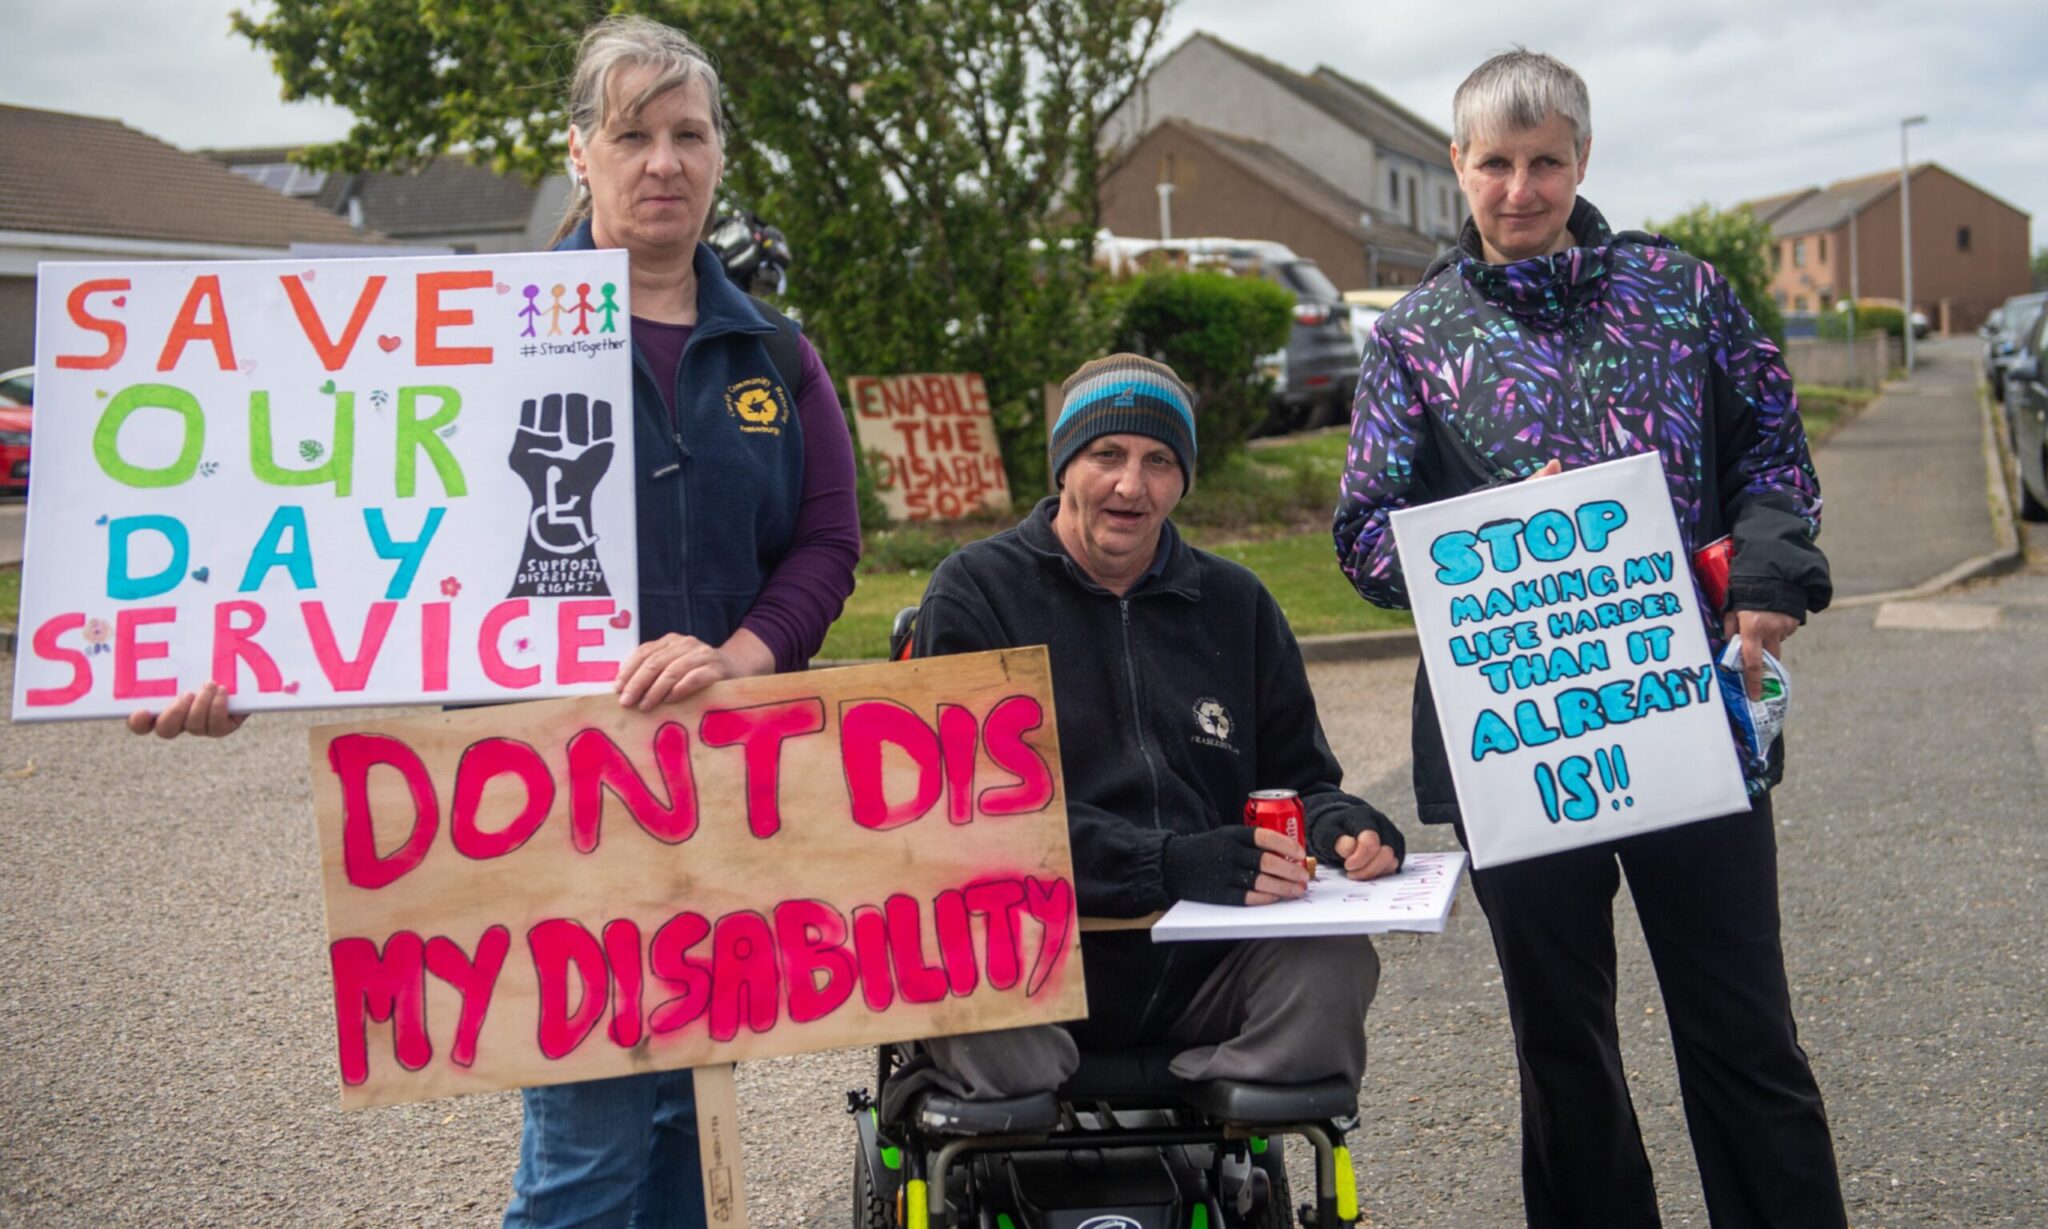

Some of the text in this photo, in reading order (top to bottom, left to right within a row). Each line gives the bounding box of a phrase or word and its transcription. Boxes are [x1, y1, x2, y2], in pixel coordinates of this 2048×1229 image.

[56, 271, 493, 371] SAVE
[520, 338, 627, 359] #StandTogether
[855, 372, 992, 419] ENABLE
[93, 384, 468, 497] OUR
[892, 419, 981, 453] THE
[106, 505, 447, 600] DAY
[518, 571, 602, 584] DISABILITY
[527, 558, 598, 572] SUPPORT
[1430, 499, 1628, 586] STOP
[537, 581, 594, 594] RIGHTS
[1450, 565, 1619, 627] MAKING
[25, 598, 621, 707] SERVICE
[1449, 591, 1682, 667] LIFE HARDER
[1479, 626, 1674, 695] THAN IT
[1471, 664, 1713, 762] ALREADY
[1533, 743, 1635, 823] IS!!
[330, 873, 1074, 1086] MY DISABILITY
